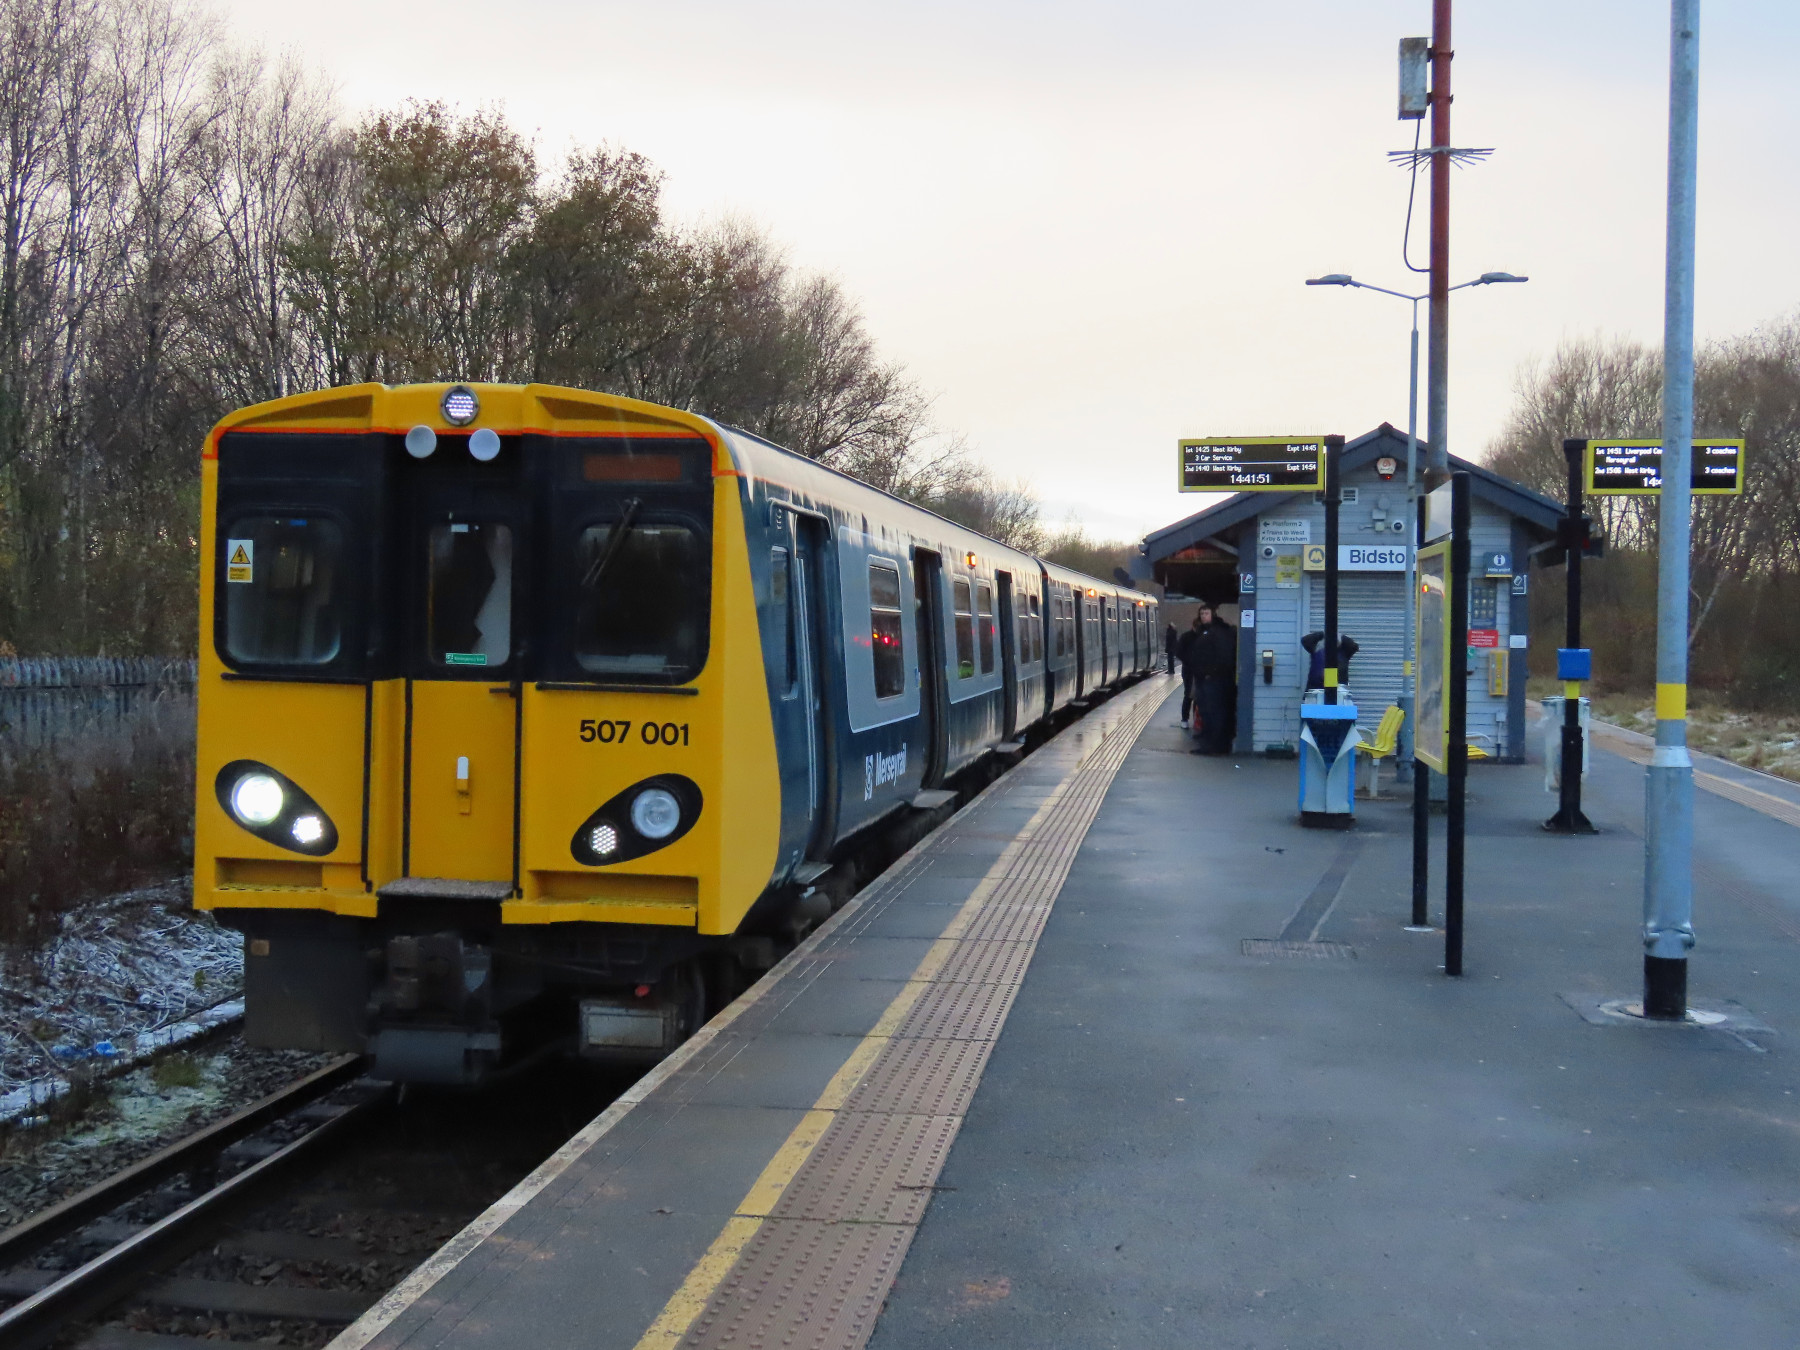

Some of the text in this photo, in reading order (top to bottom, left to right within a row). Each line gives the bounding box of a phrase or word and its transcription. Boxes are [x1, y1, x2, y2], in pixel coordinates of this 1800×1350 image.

[1227, 446, 1242, 454] Kirby
[1286, 445, 1300, 453] Expt
[1625, 447, 1652, 456] Liverpool
[1705, 447, 1737, 455] 3 coaches
[1227, 465, 1242, 473] Kirby
[1286, 464, 1300, 472] Expt
[1639, 467, 1656, 476] Kirby
[1230, 474, 1270, 484] 14:41:51
[1350, 549, 1416, 564] Bidsto
[580, 719, 689, 746] 507 001
[876, 742, 906, 787] Merseyrail
